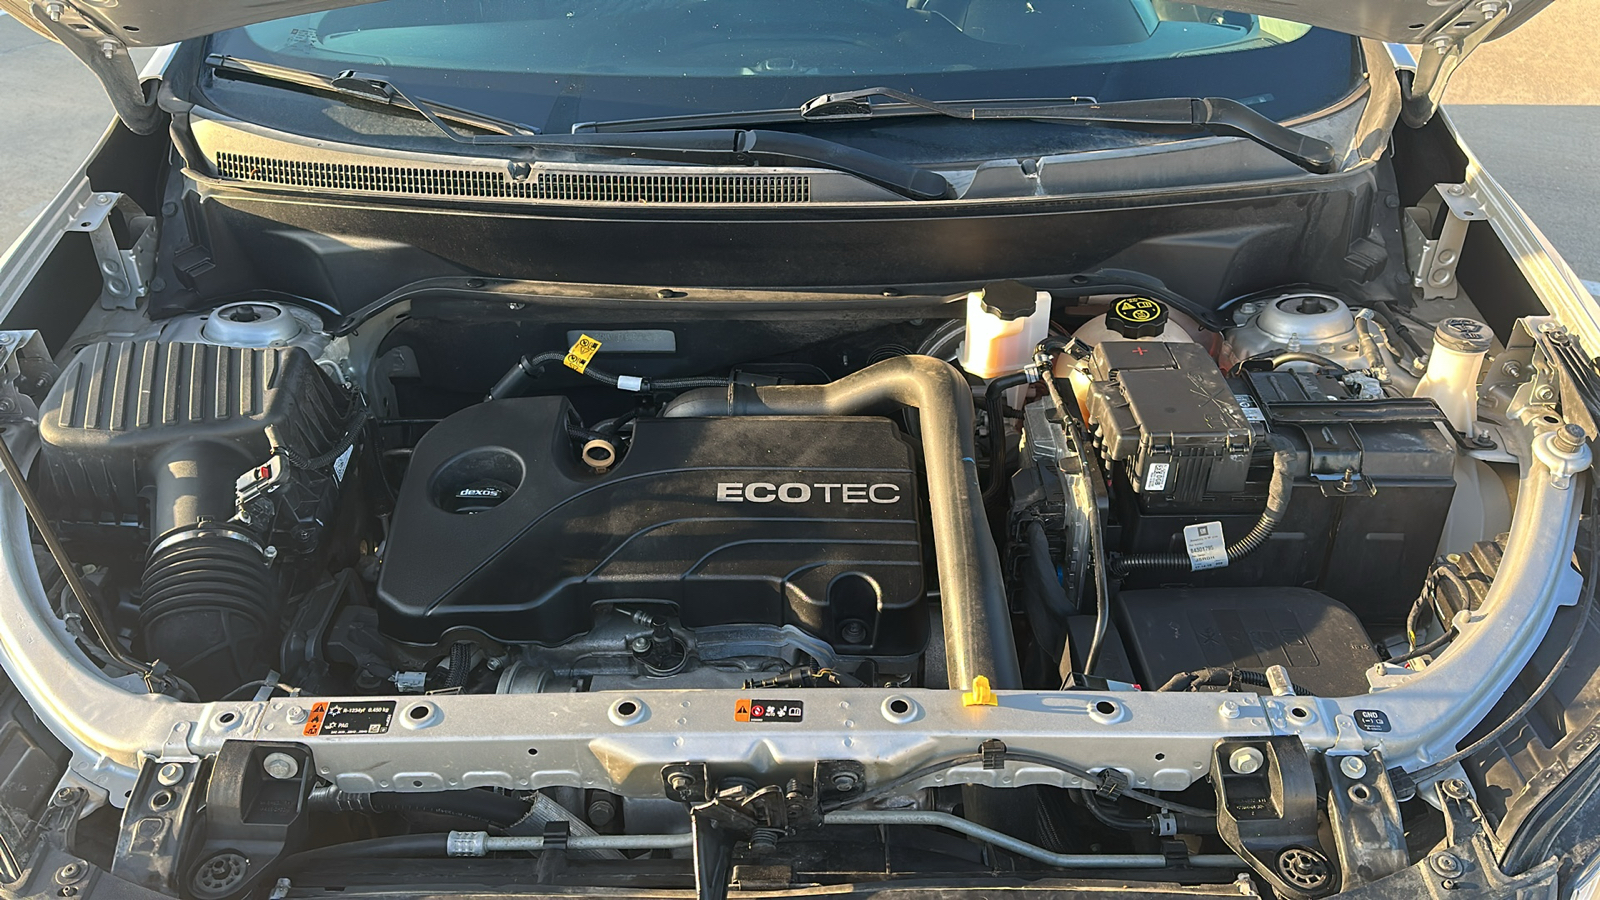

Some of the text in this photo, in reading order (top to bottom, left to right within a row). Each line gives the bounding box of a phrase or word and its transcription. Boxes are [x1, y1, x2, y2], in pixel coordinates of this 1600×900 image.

[460, 488, 498, 497] dexos
[716, 482, 901, 504] ECOTEC
[1362, 711, 1378, 719] GND
